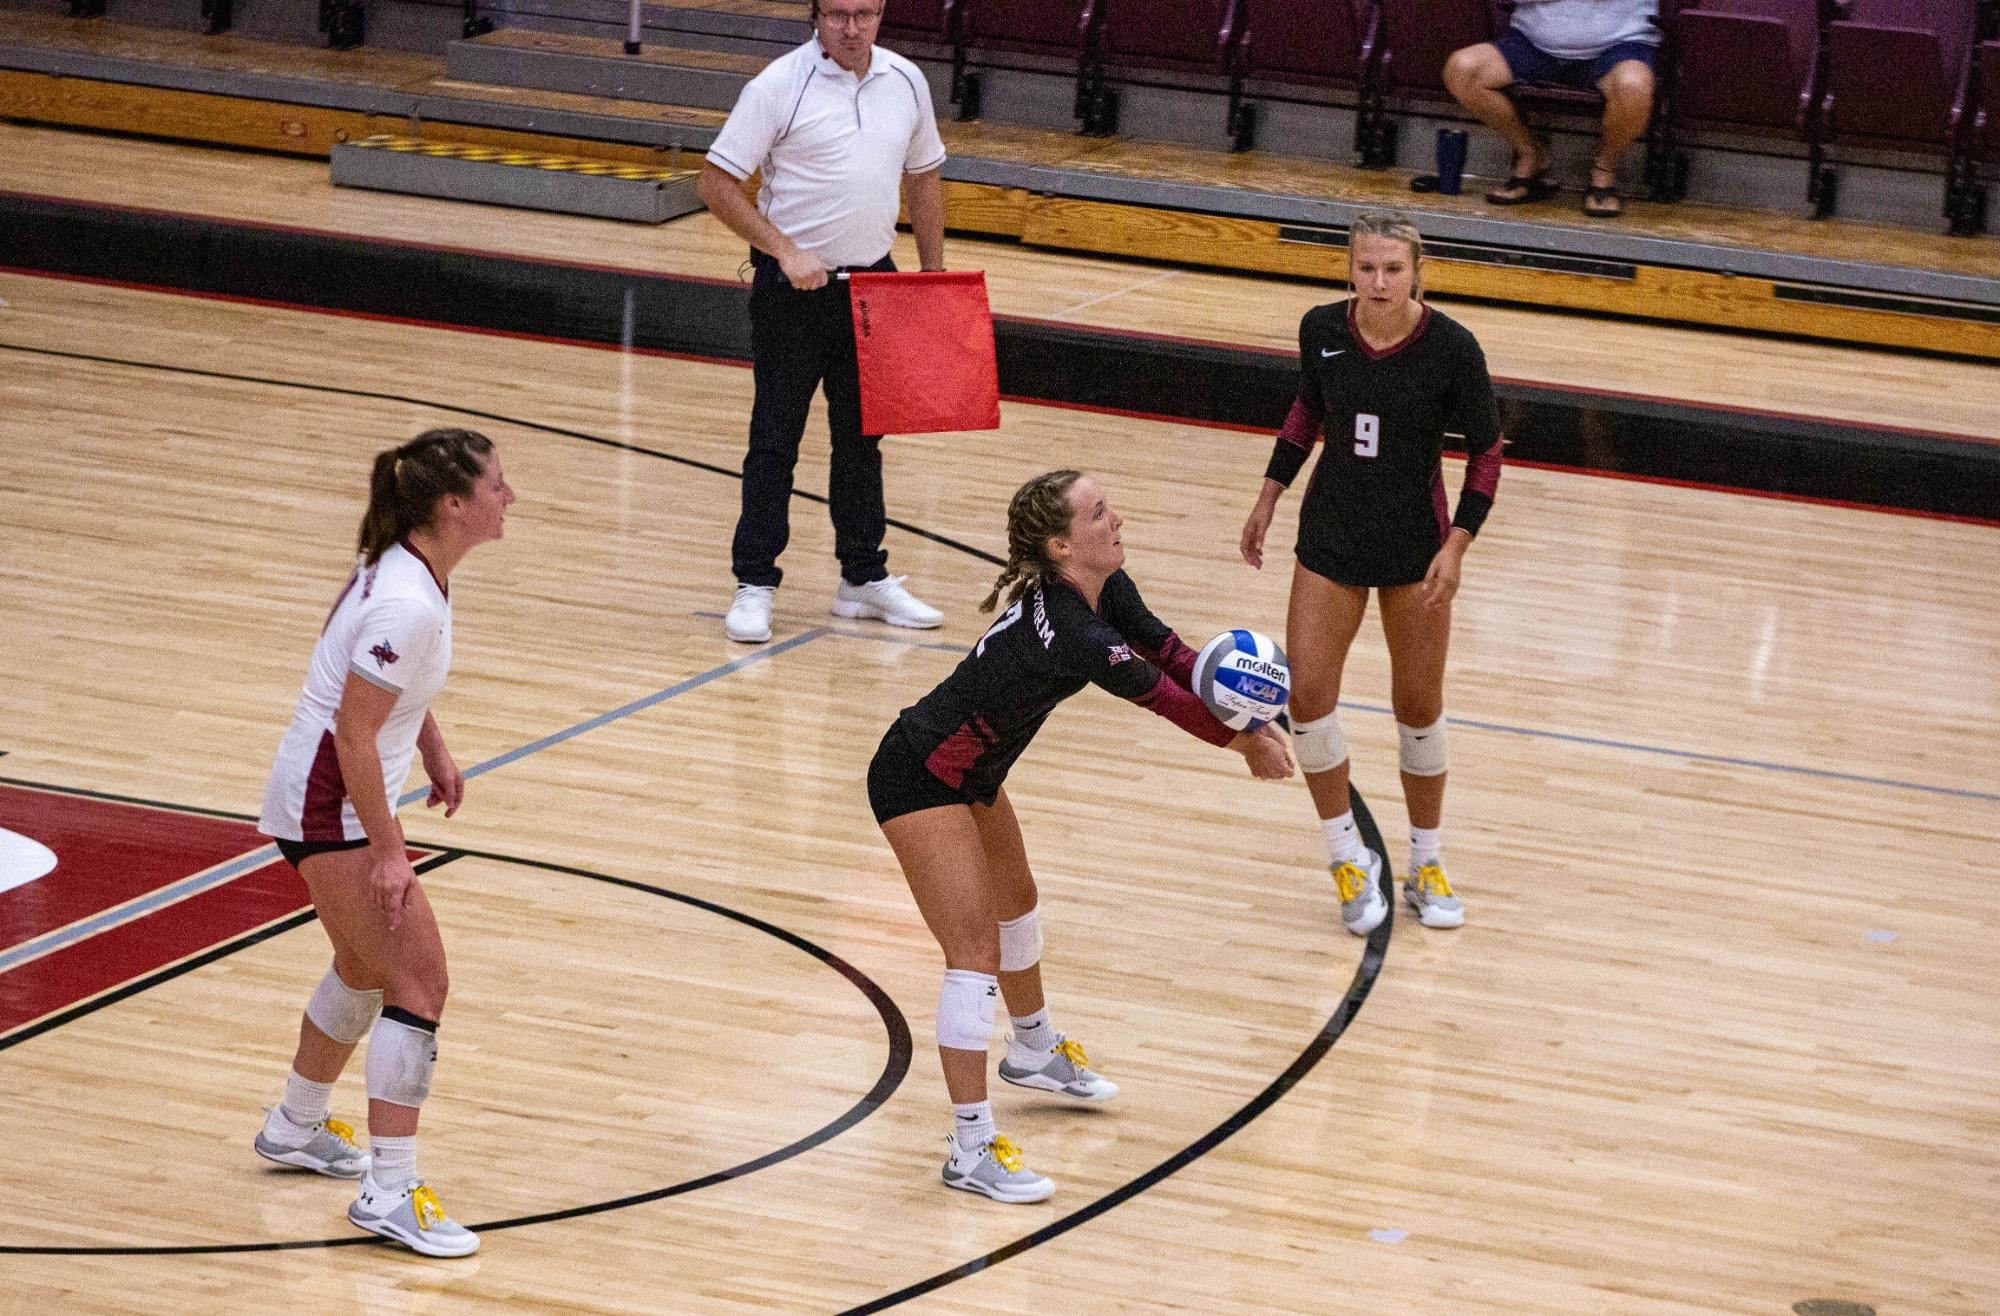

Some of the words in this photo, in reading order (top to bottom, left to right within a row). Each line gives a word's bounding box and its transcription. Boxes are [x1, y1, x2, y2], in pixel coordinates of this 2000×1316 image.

[1354, 413, 1380, 457] 9
[1236, 657, 1286, 684] molten
[1235, 675, 1280, 701] NCAA
